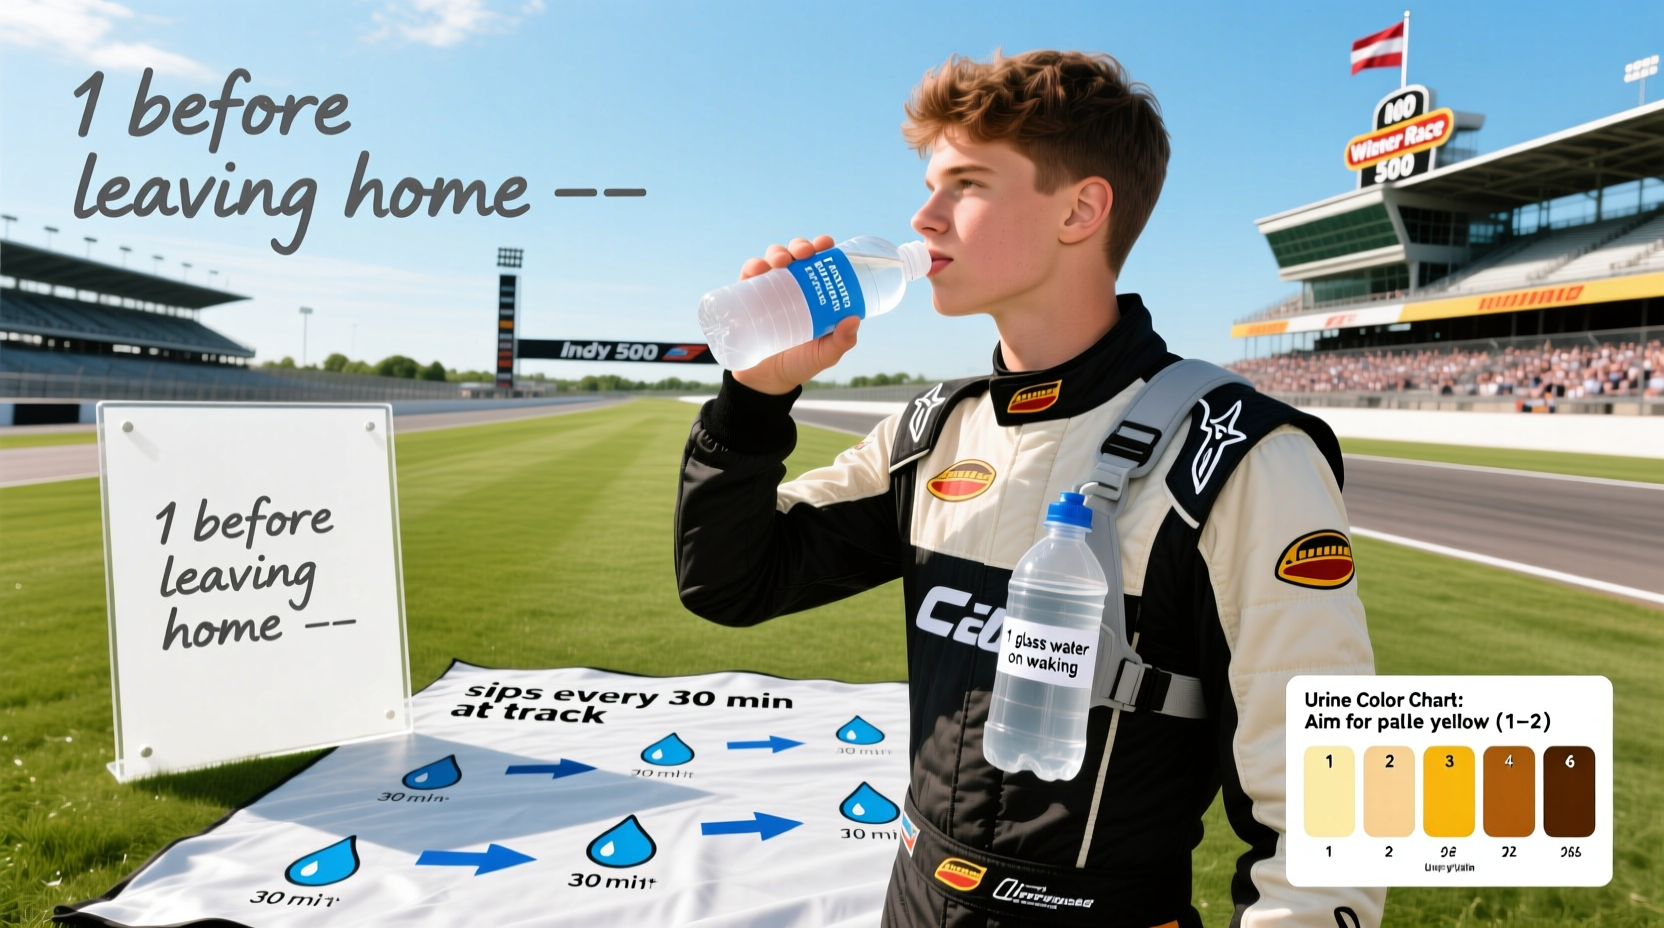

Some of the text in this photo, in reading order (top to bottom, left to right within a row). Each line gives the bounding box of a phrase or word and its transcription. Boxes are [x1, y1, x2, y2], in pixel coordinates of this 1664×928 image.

[1404, 120, 1445, 146] Race
[1374, 153, 1415, 183] 500
[560, 341, 659, 361] Indy 500
[156, 495, 334, 550] 1 before
[160, 554, 317, 611] leaving
[162, 606, 283, 651] home
[1007, 629, 1090, 656] 1 glass water
[1008, 652, 1078, 679] on waking
[464, 682, 793, 709] sips every 30 min
[450, 702, 608, 724] at track
[840, 828, 866, 840] 30
[568, 873, 602, 888] 30
[250, 891, 285, 904] 30
